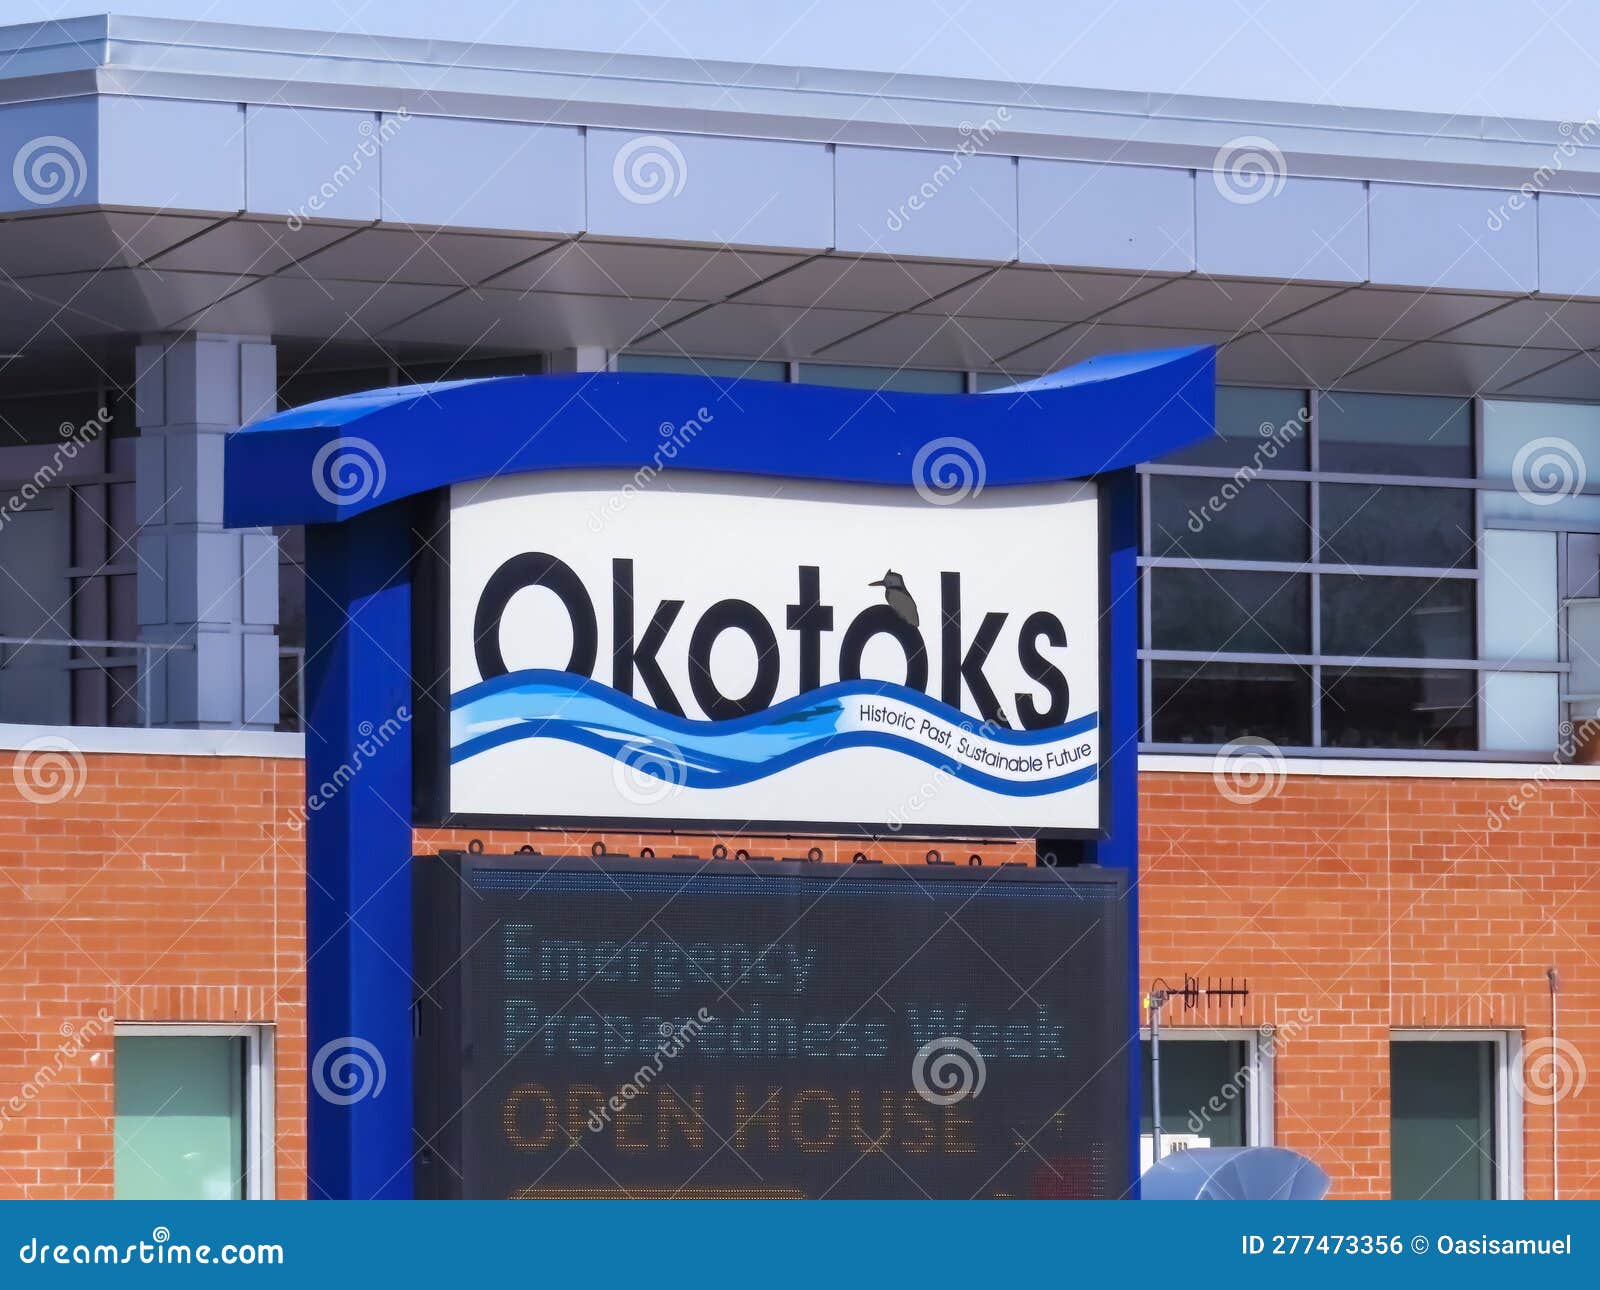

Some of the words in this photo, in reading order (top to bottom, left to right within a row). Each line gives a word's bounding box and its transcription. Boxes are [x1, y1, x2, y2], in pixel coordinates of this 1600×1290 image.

[473, 551, 1071, 731] Okotoks
[859, 704, 916, 731] Historic
[919, 719, 952, 749] Past,
[957, 737, 1043, 773] Sustainable
[1046, 743, 1092, 769] Future
[504, 923, 817, 998] Emergency
[504, 999, 890, 1064] Preparedness
[903, 1001, 1066, 1059] Week
[503, 1083, 705, 1152] OPEN
[734, 1085, 979, 1154] HOUSE
